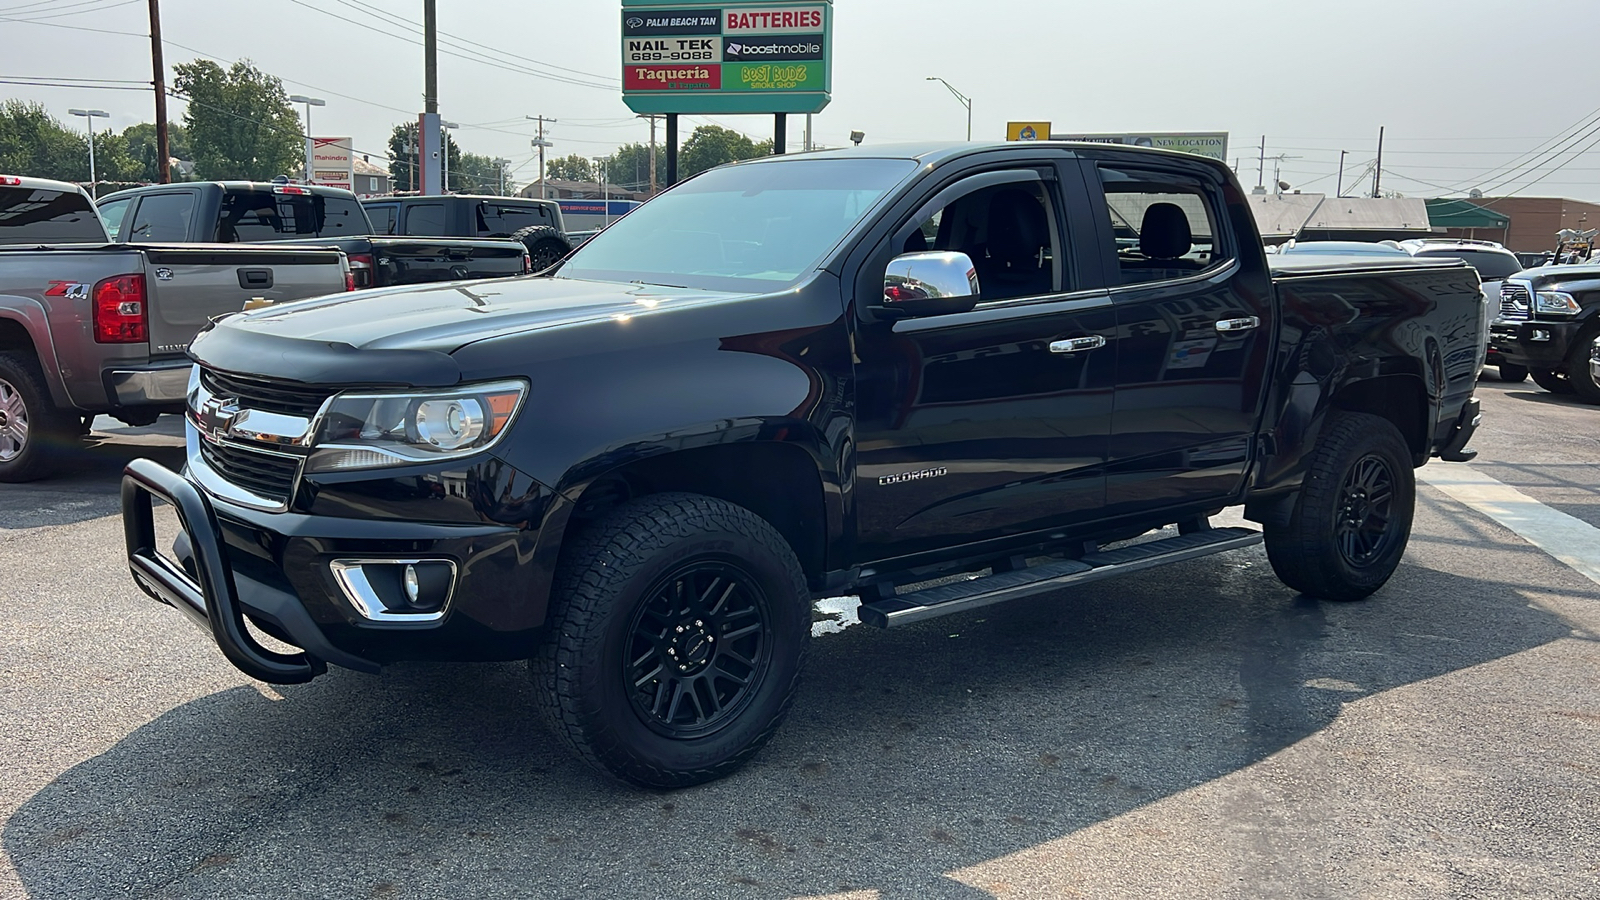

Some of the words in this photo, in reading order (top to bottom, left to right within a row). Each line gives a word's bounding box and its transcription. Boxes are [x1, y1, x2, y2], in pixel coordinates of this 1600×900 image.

[646, 18, 669, 27] PALM
[670, 17, 698, 26] BEACH
[699, 17, 716, 26] TAN
[727, 10, 821, 29] BATTERIES
[629, 40, 669, 51] NAIL
[676, 39, 714, 50] TEK
[631, 51, 713, 61] 689-9088
[1177, 138, 1222, 146] LOCATION
[45, 279, 91, 296] Z71
[878, 466, 947, 486] COLORADO
